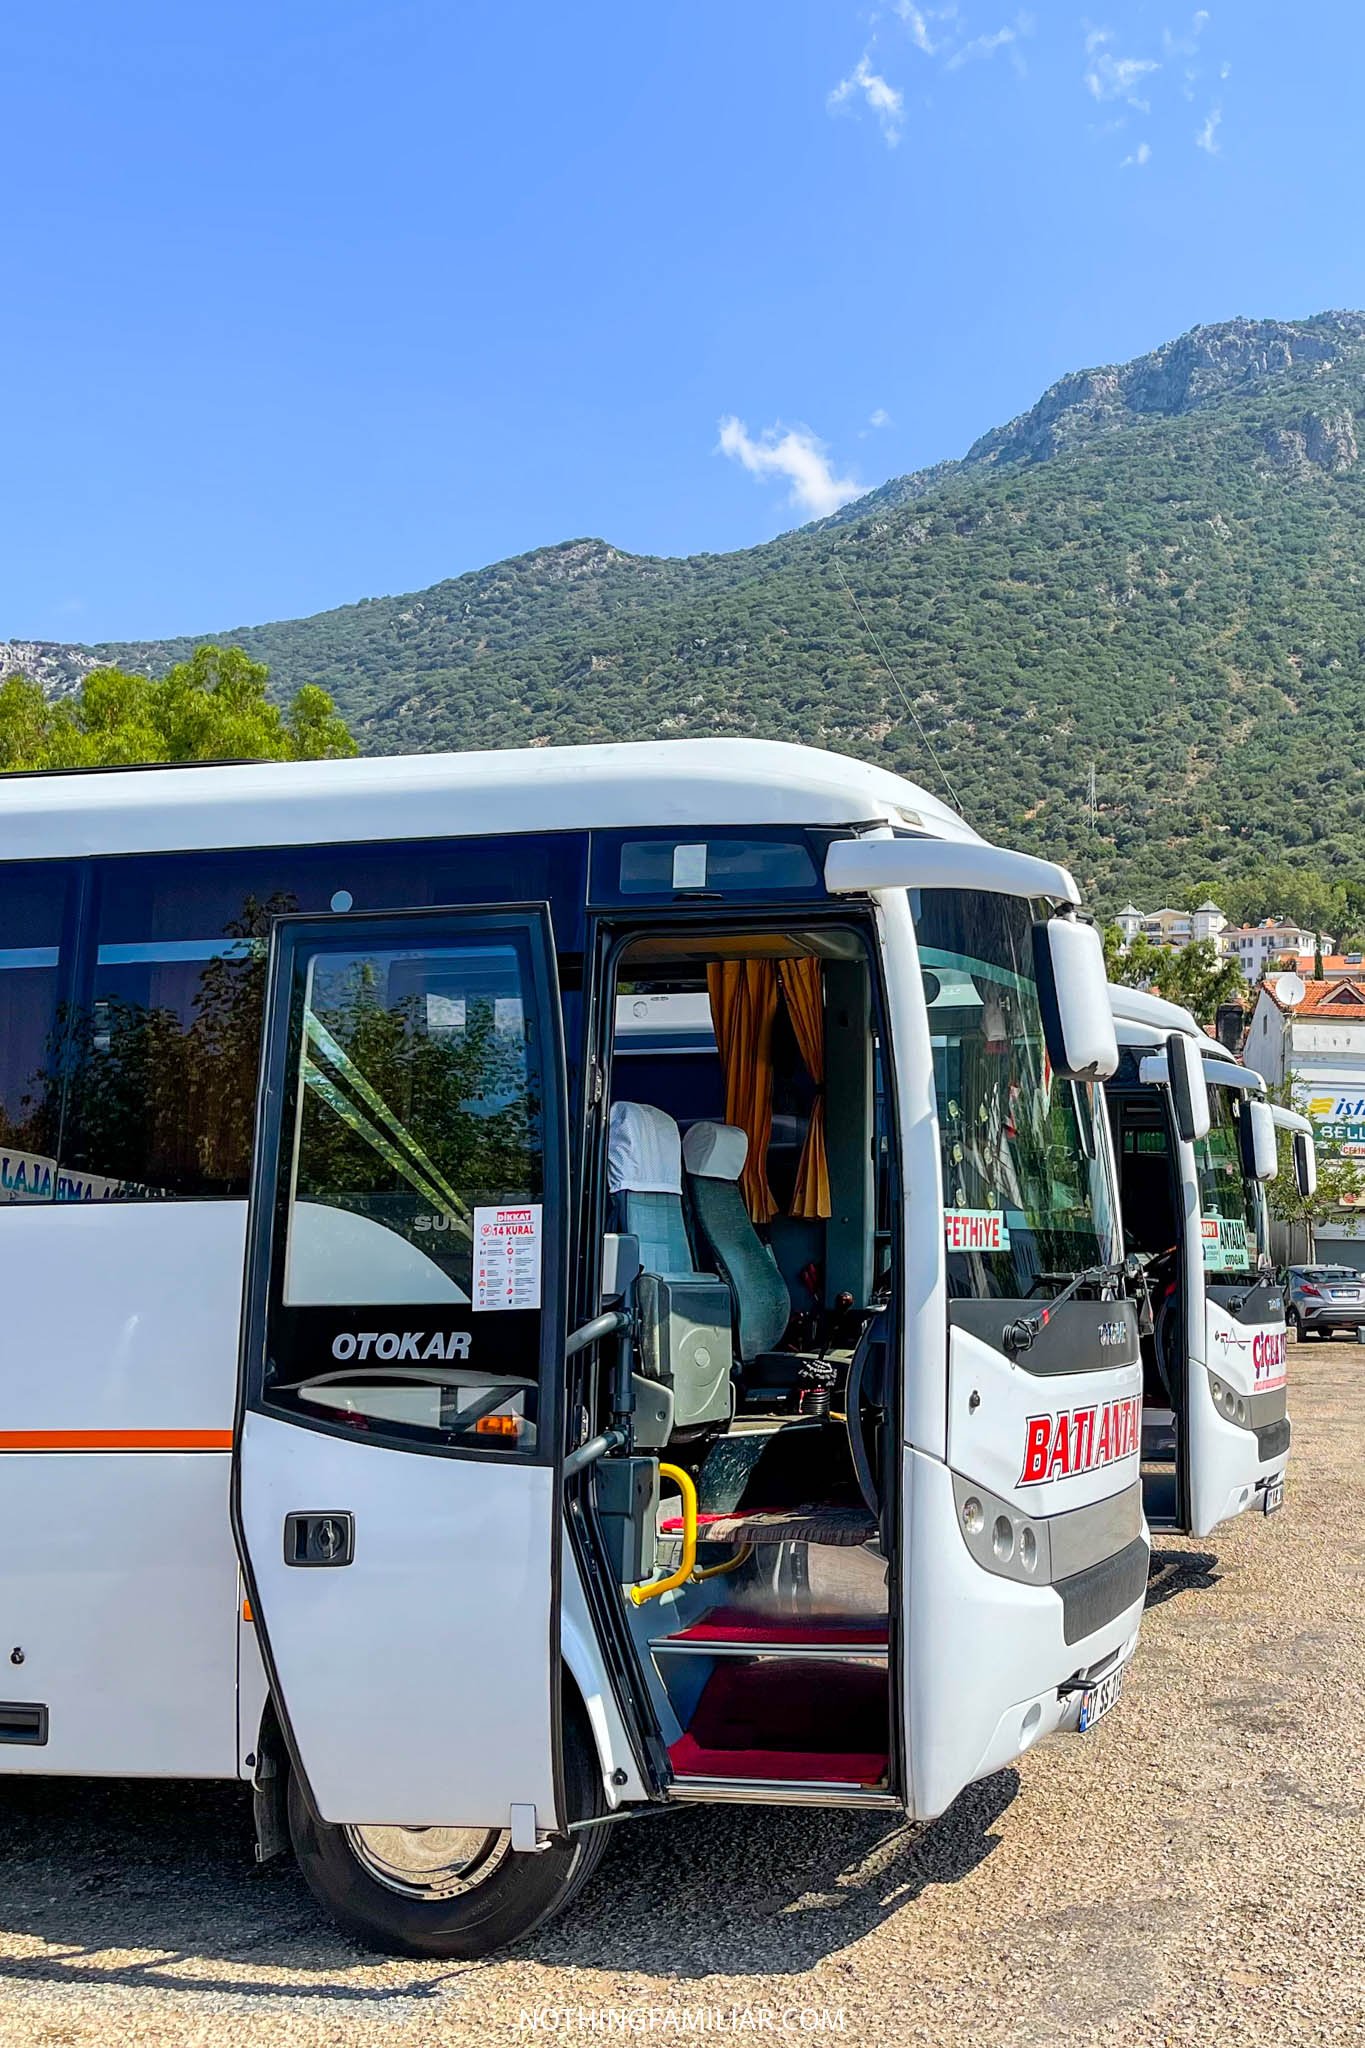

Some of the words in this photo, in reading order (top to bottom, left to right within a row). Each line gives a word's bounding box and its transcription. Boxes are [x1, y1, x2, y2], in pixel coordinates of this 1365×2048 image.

[506, 1225, 534, 1236] KURAL
[332, 1332, 473, 1360] OTOKAR
[1017, 1406, 1097, 1486] BATI
